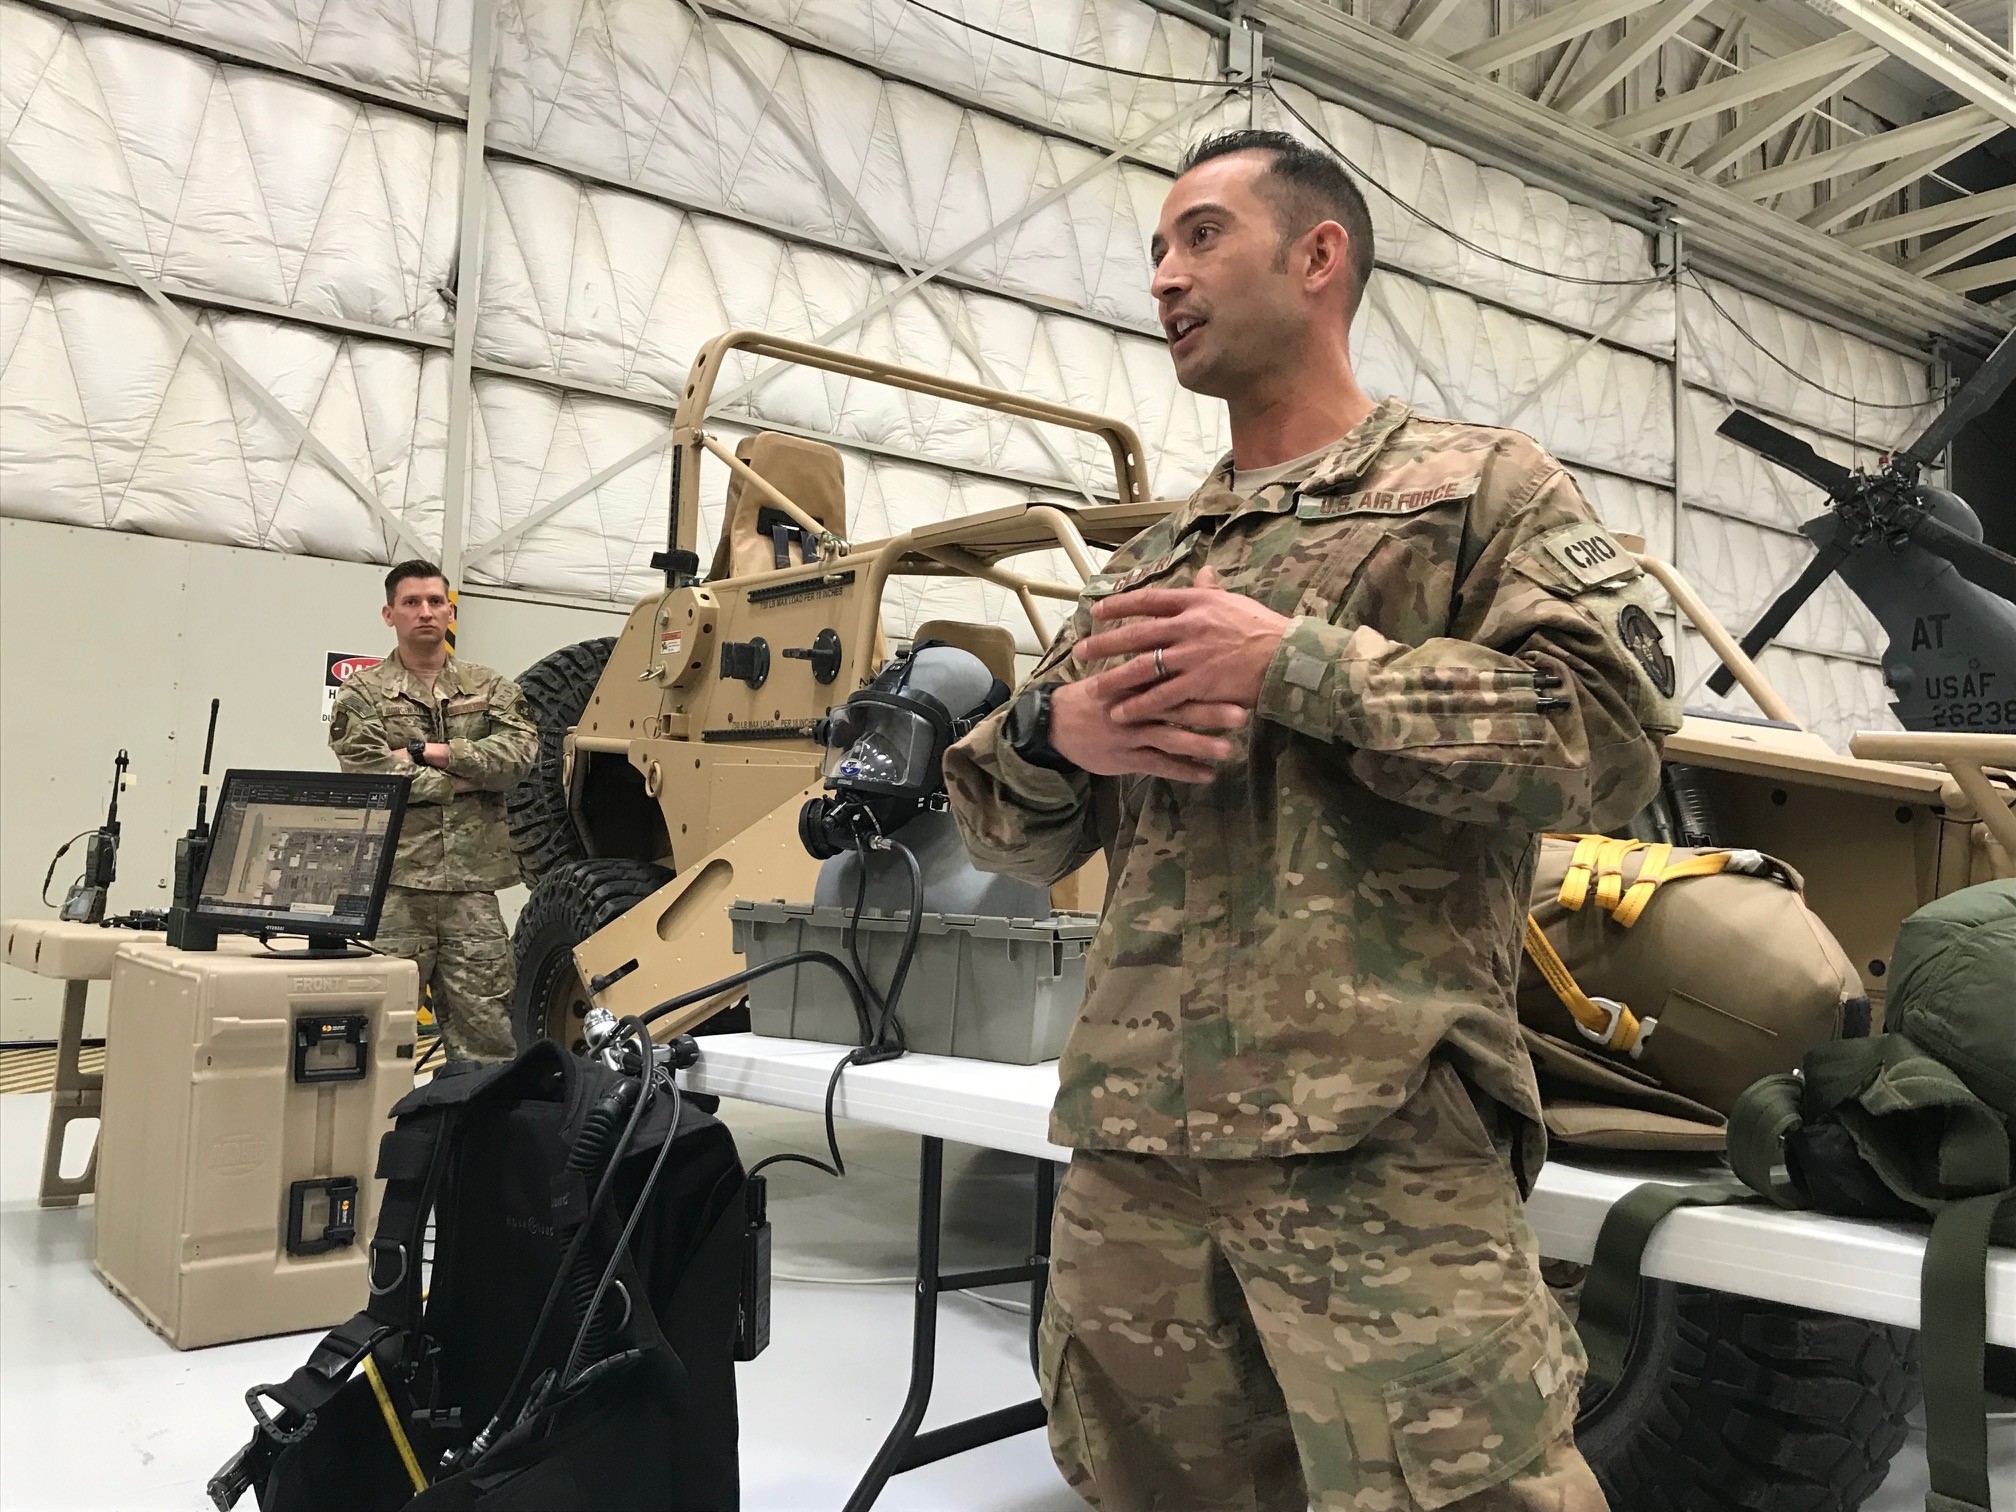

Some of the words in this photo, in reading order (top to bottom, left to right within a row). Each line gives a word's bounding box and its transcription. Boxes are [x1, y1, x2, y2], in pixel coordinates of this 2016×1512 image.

[1319, 496, 1352, 515] U.S.
[1358, 492, 1394, 510] AIR
[1397, 482, 1459, 511] FORCE
[1564, 535, 1617, 569] CRO
[777, 598, 788, 607] MAX
[788, 596, 804, 605] LOAD
[804, 593, 815, 602] PER
[822, 587, 843, 599] INCHES
[1911, 612, 1950, 651] AT
[1925, 672, 1996, 700] USAF
[748, 720, 759, 728] MAX
[760, 720, 775, 728] LOAD
[780, 719, 791, 727] PER
[798, 718, 817, 727] INCHE
[293, 977, 342, 992] FRONT
